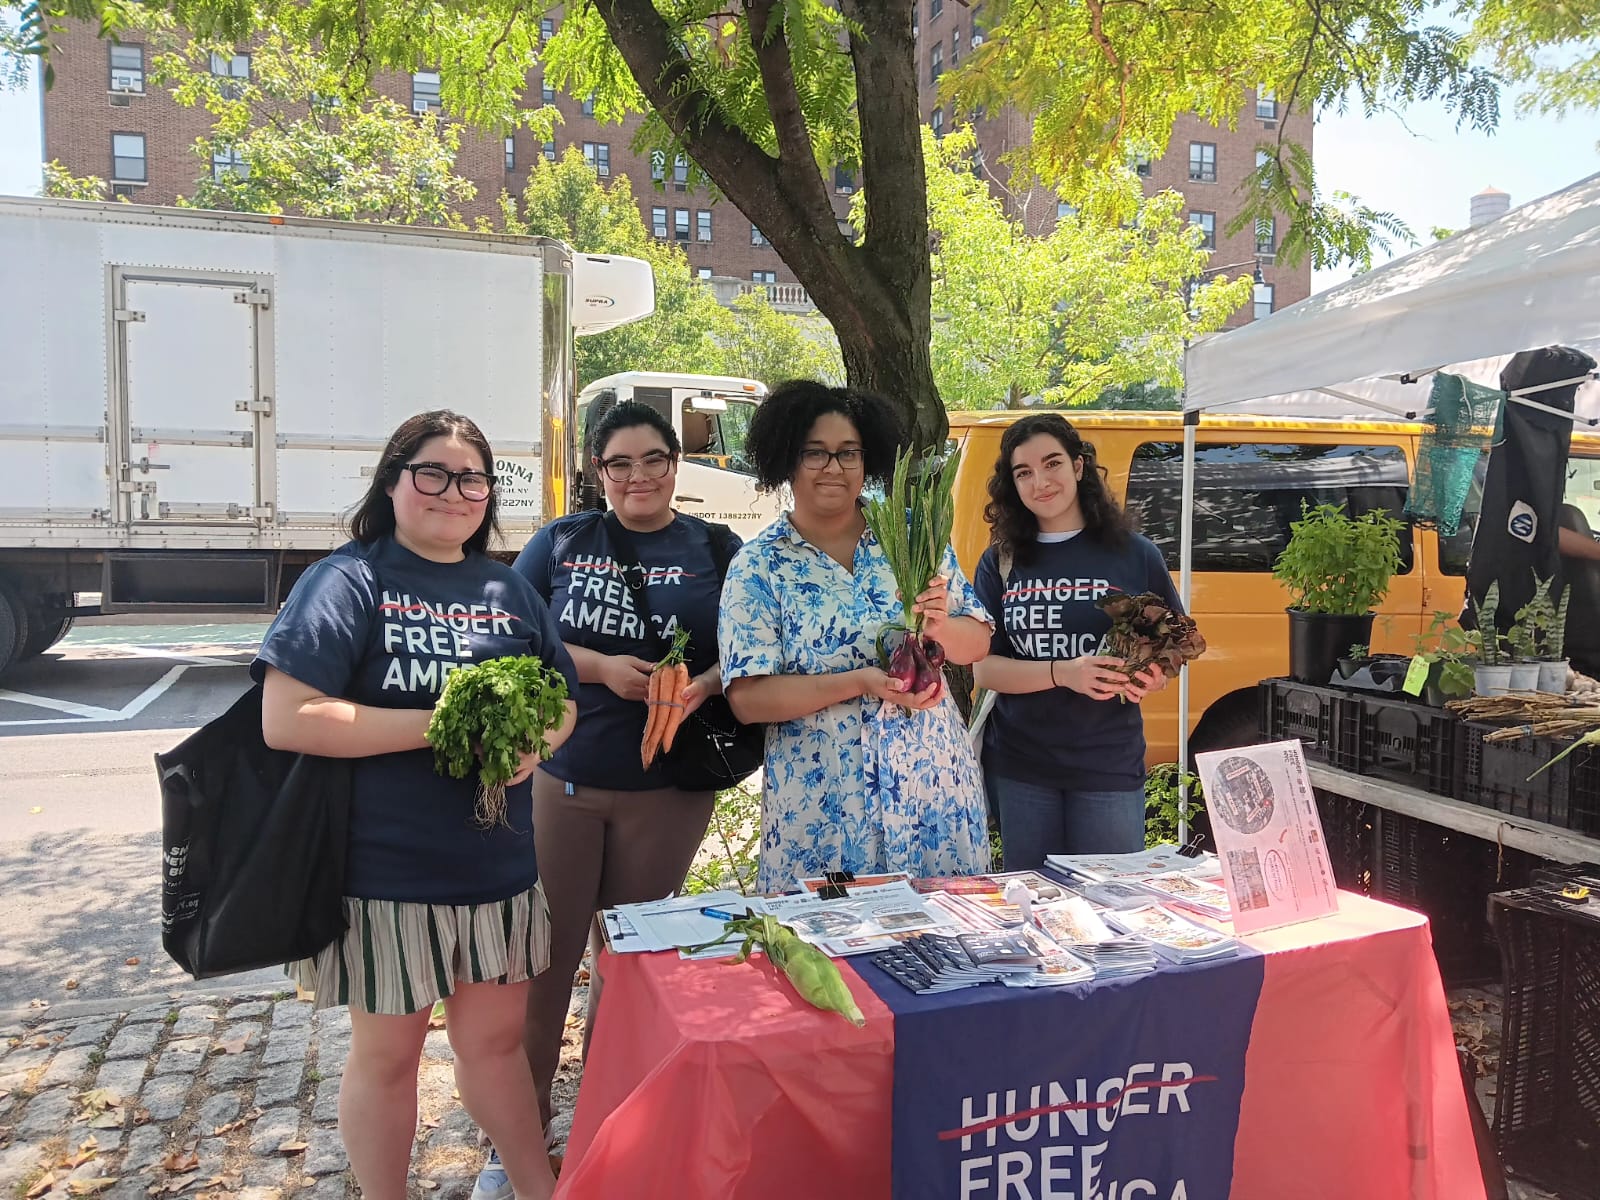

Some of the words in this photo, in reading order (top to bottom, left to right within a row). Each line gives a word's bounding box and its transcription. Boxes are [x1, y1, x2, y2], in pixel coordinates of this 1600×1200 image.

[567, 571, 635, 612] FREE
[1003, 577, 1111, 605] HUNGER
[382, 590, 514, 636] HUNGER
[1004, 604, 1063, 632] FREE
[384, 622, 473, 657] FREE
[960, 1061, 1194, 1152] HUNGER
